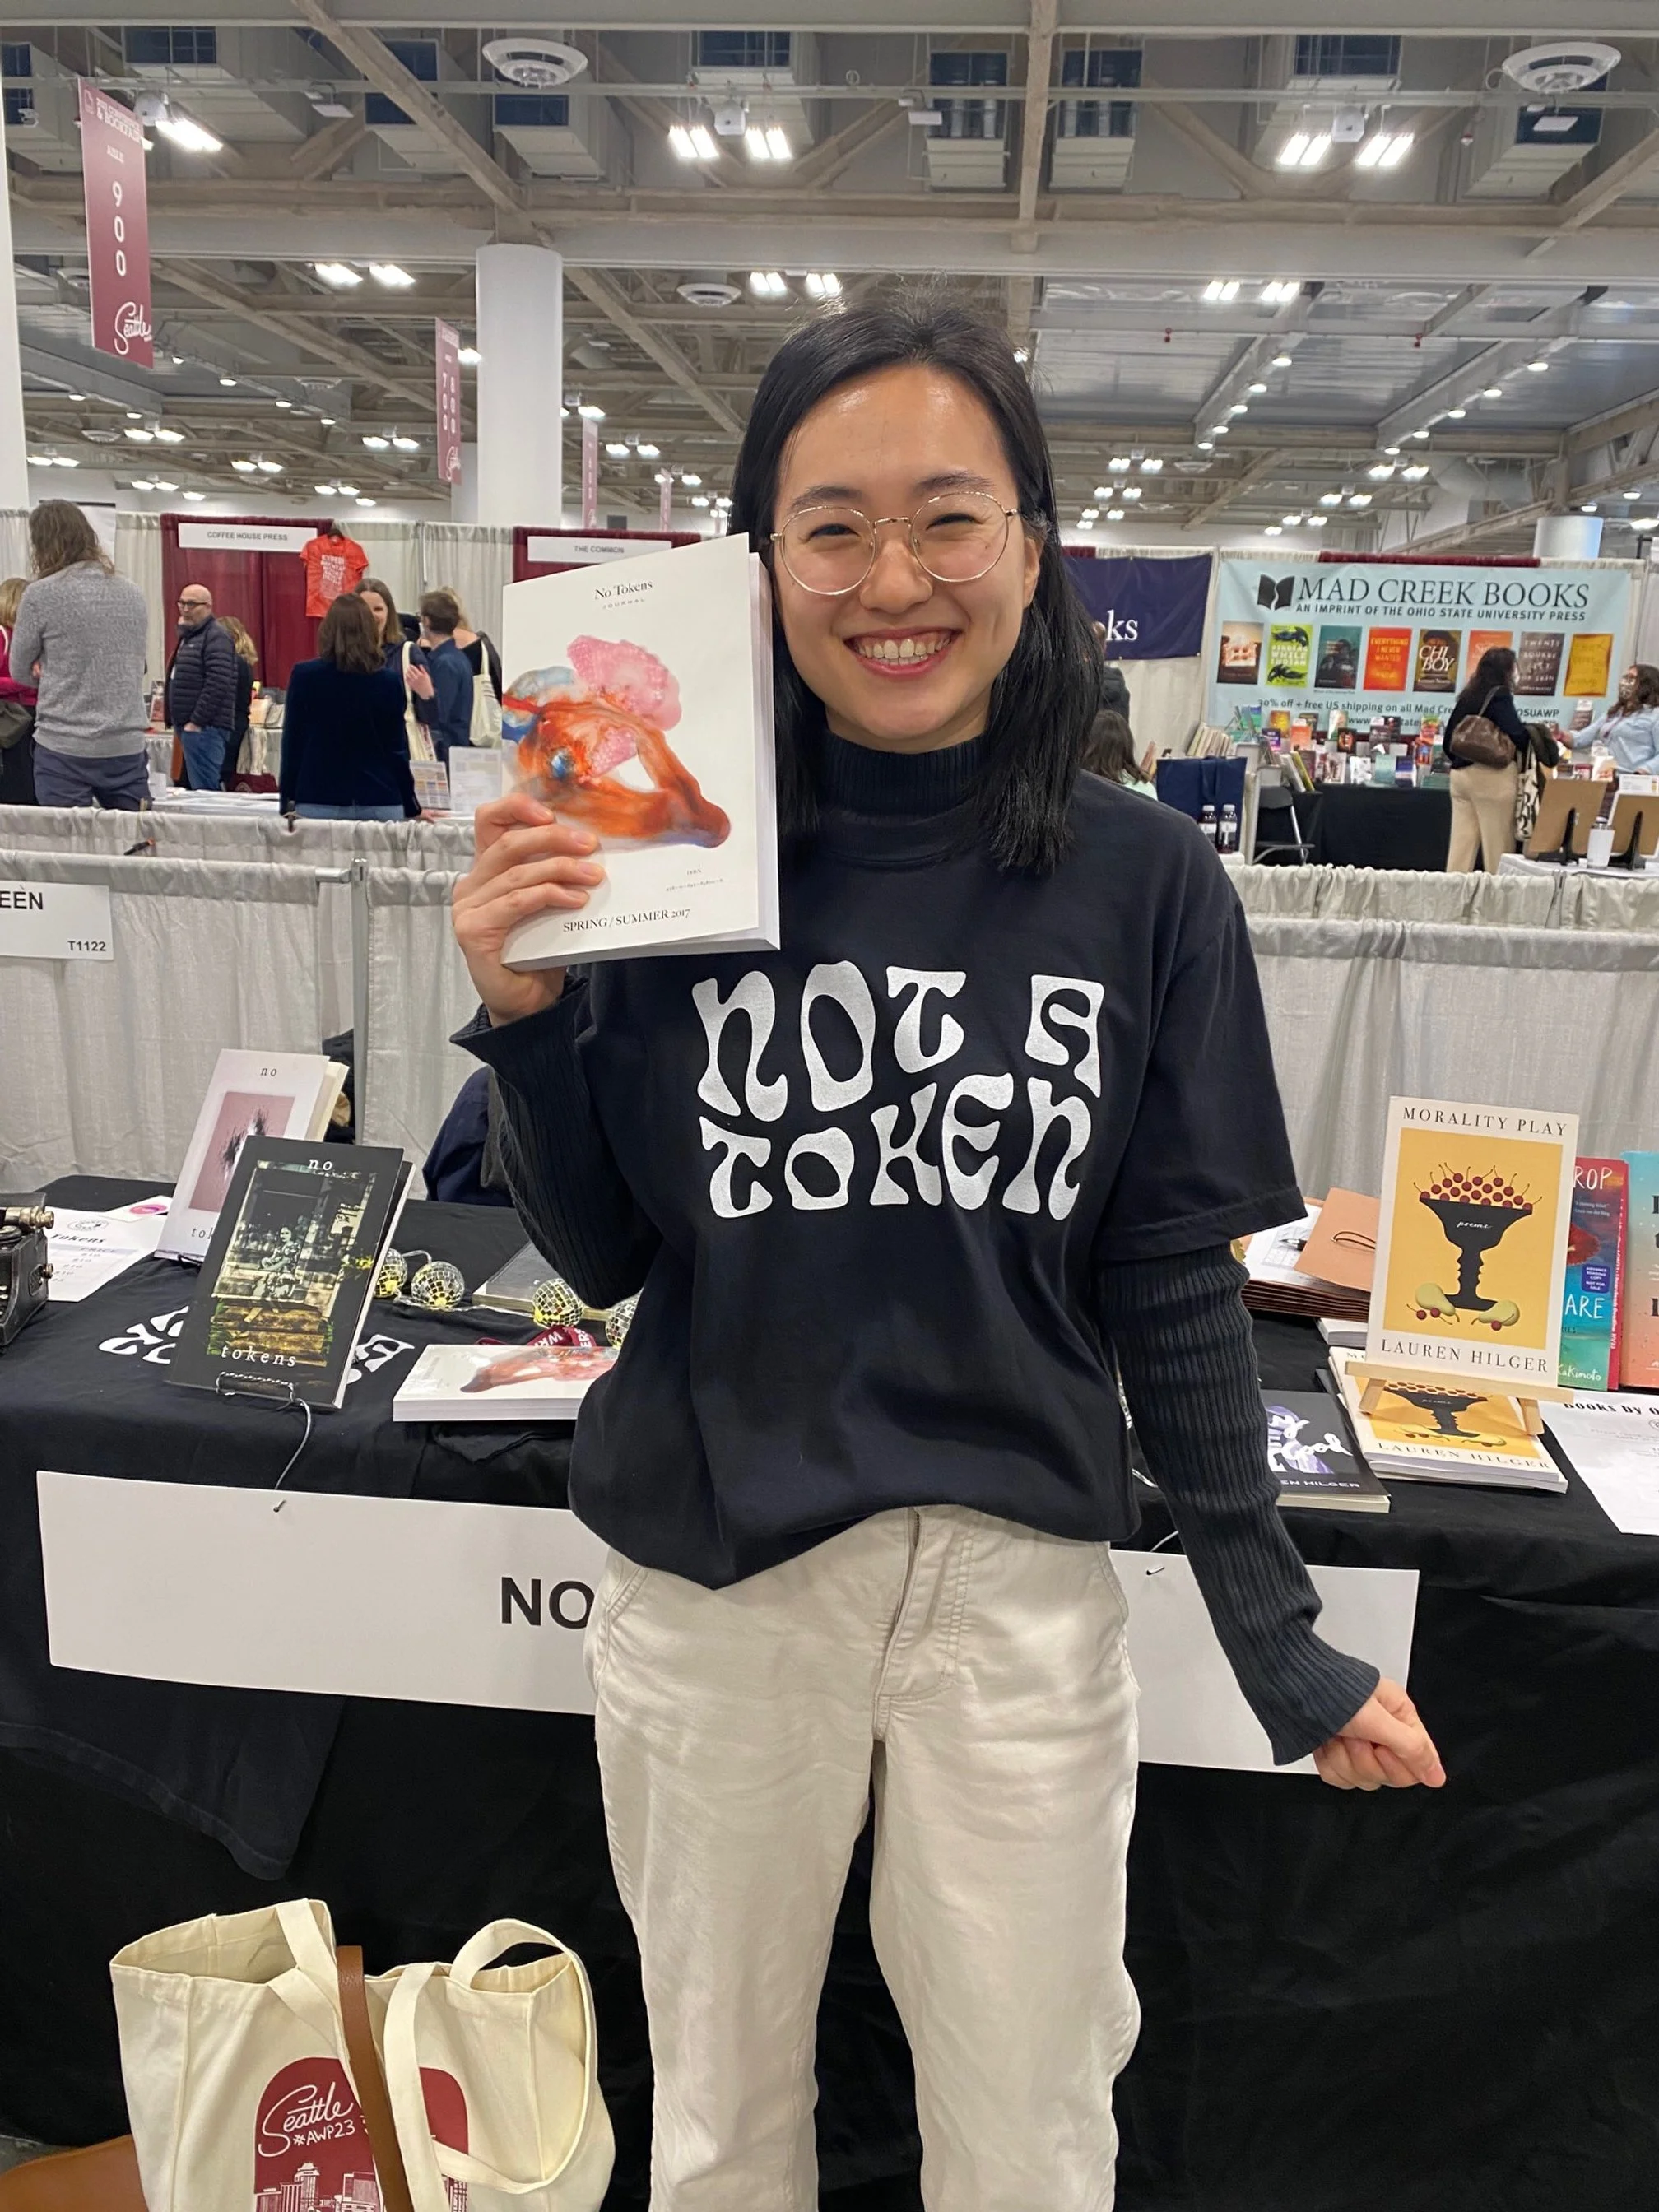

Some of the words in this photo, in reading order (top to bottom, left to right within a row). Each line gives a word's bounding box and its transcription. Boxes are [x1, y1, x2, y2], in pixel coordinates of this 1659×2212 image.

[112, 180, 127, 276] 900
[114, 301, 152, 355] Seattle
[207, 531, 235, 539] COFFEE
[263, 533, 288, 541] PRESS
[574, 545, 588, 553] THE
[590, 546, 624, 554] COMMON
[594, 588, 612, 600] No
[613, 581, 653, 597] Tokens
[1298, 577, 1369, 602] MAD
[1378, 579, 1476, 605] CREEK
[1483, 581, 1589, 609] BOOKS
[602, 598, 645, 610] JOURNAL
[1296, 603, 1312, 613] AN
[1315, 604, 1363, 615] IMPRINT
[1365, 606, 1379, 616] OF
[1383, 606, 1403, 616] THE
[1407, 607, 1436, 617] OHIO
[1440, 607, 1473, 618] STATE
[1477, 609, 1546, 620] UNIVERSITY
[1550, 611, 1587, 621] PRESS
[1419, 645, 1449, 659] CHI
[1422, 658, 1455, 671] BOY
[1280, 699, 1294, 708] off
[1304, 699, 1323, 709] free
[1326, 701, 1339, 710] US
[1341, 701, 1382, 713] shipping
[1400, 704, 1412, 712] all
[1415, 704, 1435, 713] Mad
[672, 908, 690, 921] 2017
[67, 940, 106, 952] T1122
[691, 960, 967, 1122] NOT
[260, 1066, 277, 1077] no
[1402, 1107, 1509, 1130] MORALITY
[1517, 1118, 1568, 1136] PLAY
[699, 1072, 1092, 1221] TOKEN
[308, 1159, 333, 1171] no
[221, 1345, 297, 1367] tokens
[1382, 1338, 1461, 1360] LAUREN
[1471, 1350, 1548, 1373] HILGER
[1621, 1404, 1642, 1415] by
[1378, 1442, 1462, 1458] LAUREN
[1470, 1455, 1550, 1470] HILGER
[1304, 1480, 1360, 1489] HILGER
[501, 1575, 596, 1630] NO
[258, 2081, 355, 2158] Seattle
